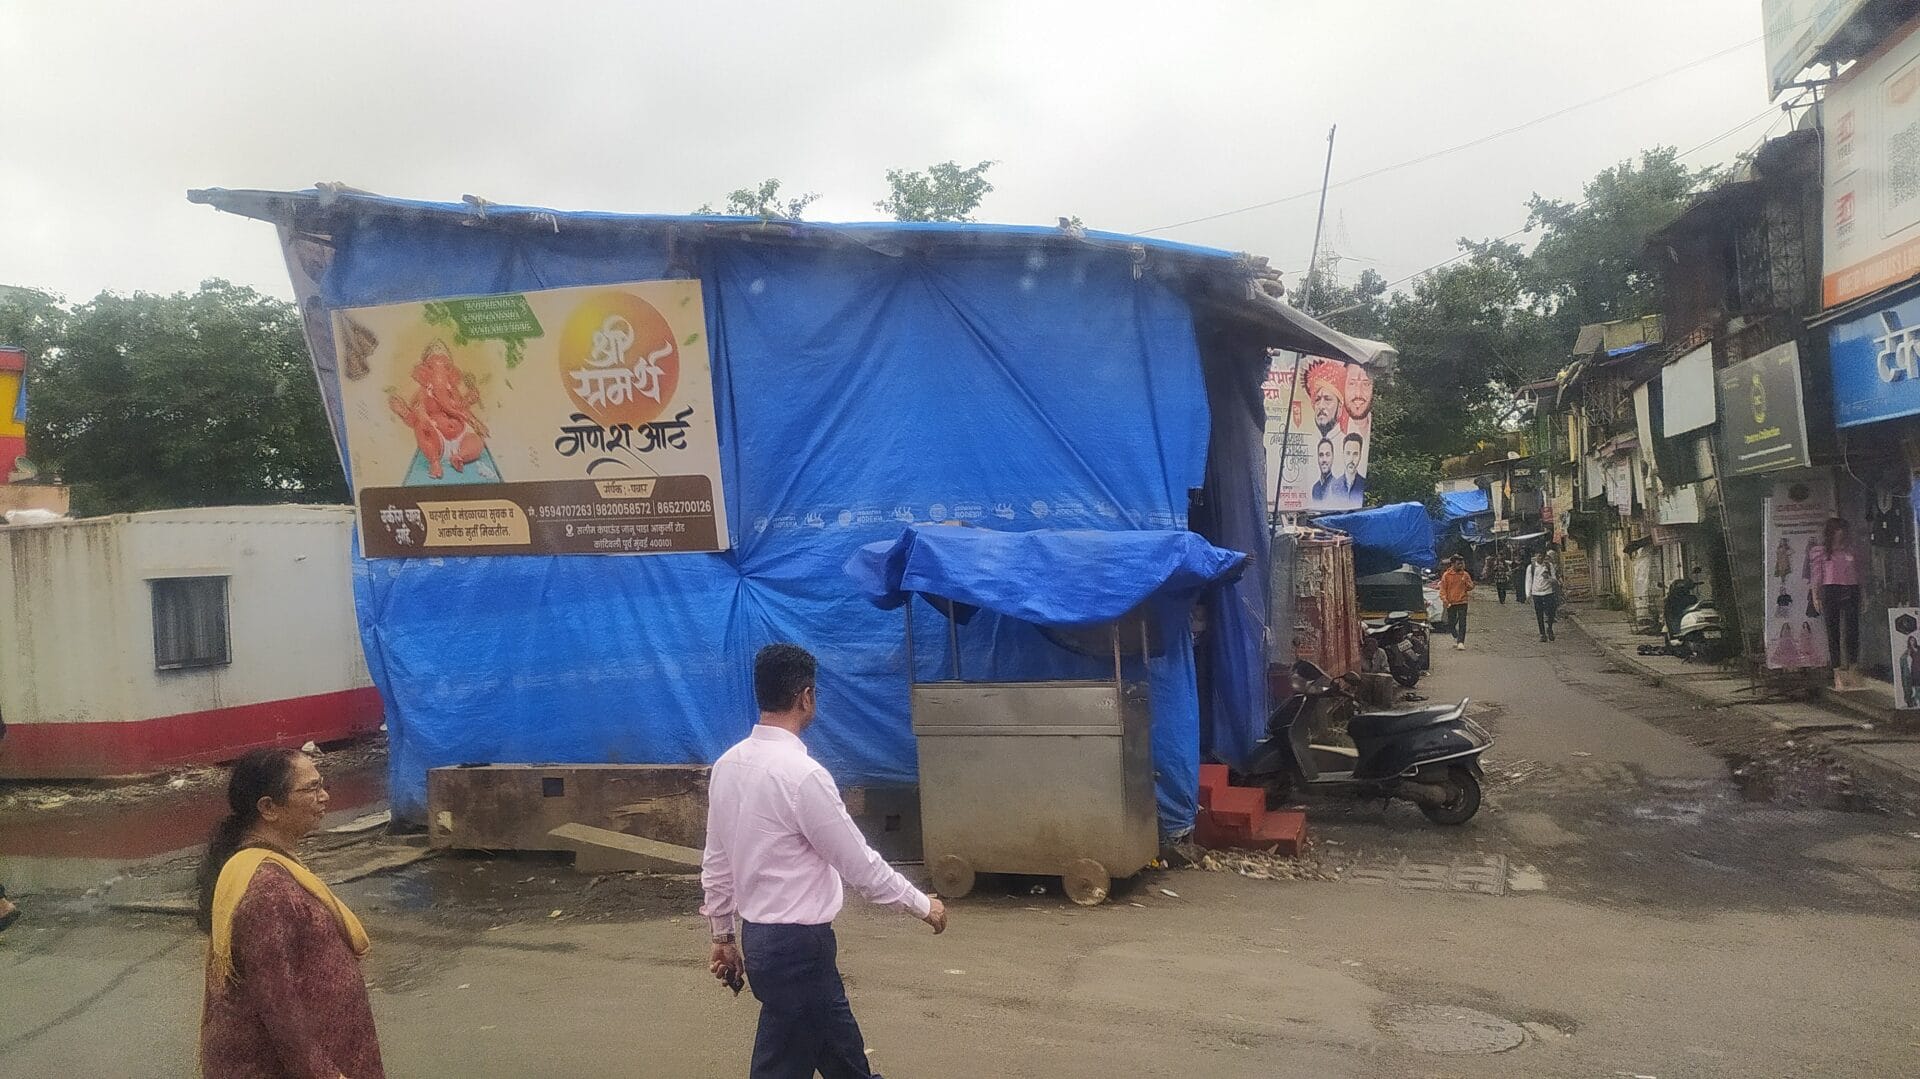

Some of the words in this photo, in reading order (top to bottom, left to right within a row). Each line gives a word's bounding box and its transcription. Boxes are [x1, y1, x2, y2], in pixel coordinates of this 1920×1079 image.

[584, 314, 634, 368] श्री
[555, 411, 635, 457] गणेश
[637, 405, 694, 453] आर्ट
[539, 503, 592, 518] 9594707263
[596, 501, 651, 516] 9820058572
[657, 500, 712, 514] 8652700126
[650, 538, 673, 548] 400101
